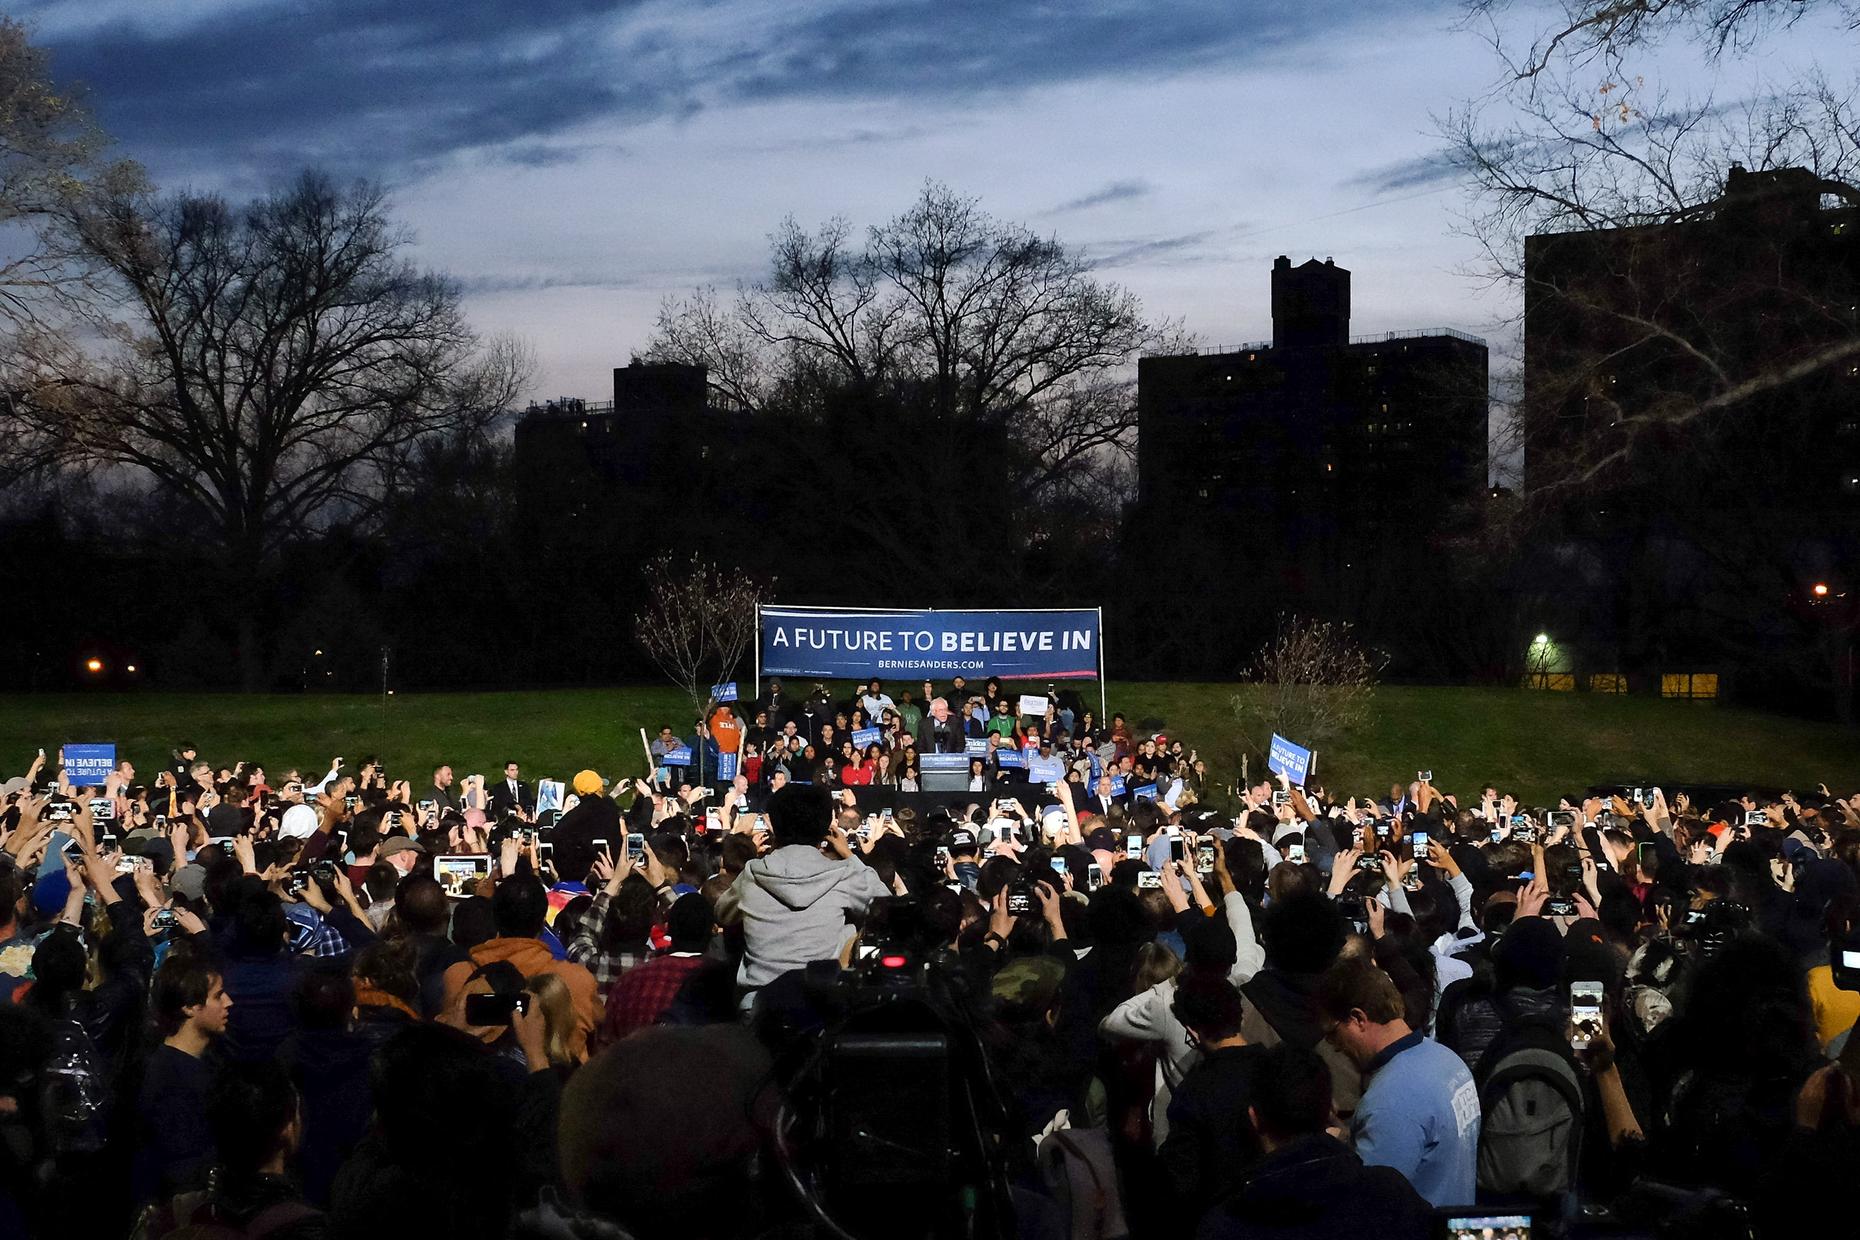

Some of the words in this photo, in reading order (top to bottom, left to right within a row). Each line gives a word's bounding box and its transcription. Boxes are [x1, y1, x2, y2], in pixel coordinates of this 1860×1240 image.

[772, 627, 789, 647] A
[795, 628, 893, 651] FUTURE
[898, 631, 934, 651] TO
[942, 631, 1054, 652] BELIEVE
[1062, 630, 1091, 650] IN
[878, 660, 984, 669] BERNIESANDERS.COM
[65, 759, 75, 767] IN
[77, 759, 112, 767] BELIEVE
[66, 768, 76, 776] TO
[77, 768, 107, 776] FUTURE
